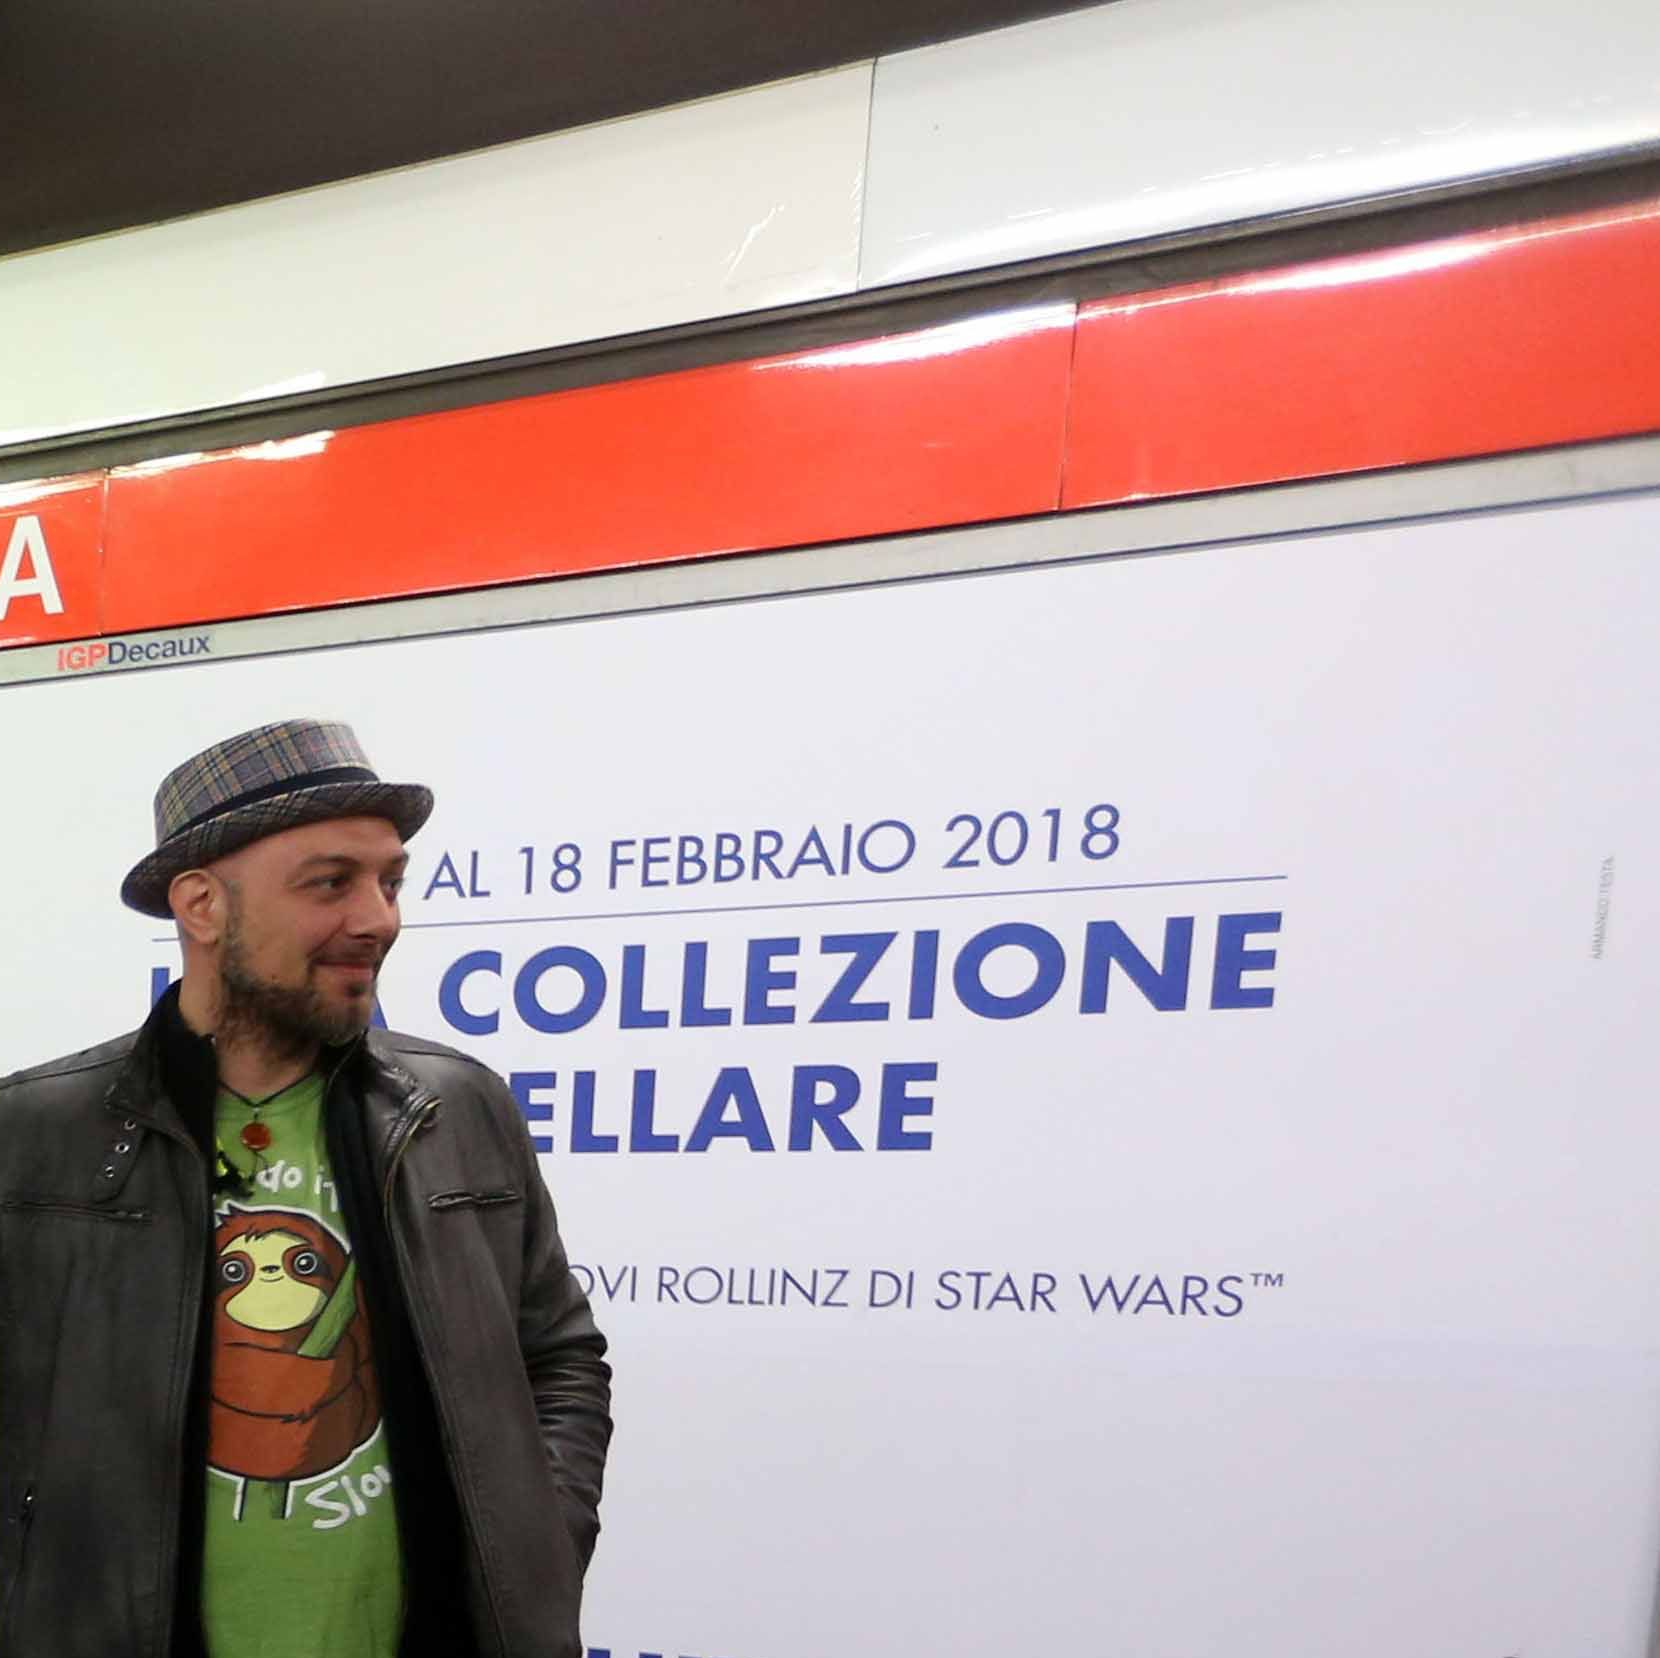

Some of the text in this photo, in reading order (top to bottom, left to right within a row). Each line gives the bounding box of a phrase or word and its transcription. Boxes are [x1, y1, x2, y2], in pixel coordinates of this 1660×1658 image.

[57, 634, 212, 673] IGPDecaux
[423, 803, 1121, 902] AL 18 FEBBRAIO 2018
[438, 911, 1283, 1036] COLLEZIONE
[509, 1063, 939, 1154] ELLARE
[256, 1160, 302, 1193] do
[569, 1264, 637, 1302] OVI
[657, 1266, 849, 1307] ROLLINZ
[870, 1269, 915, 1310] DI
[934, 1271, 1057, 1314] STAR
